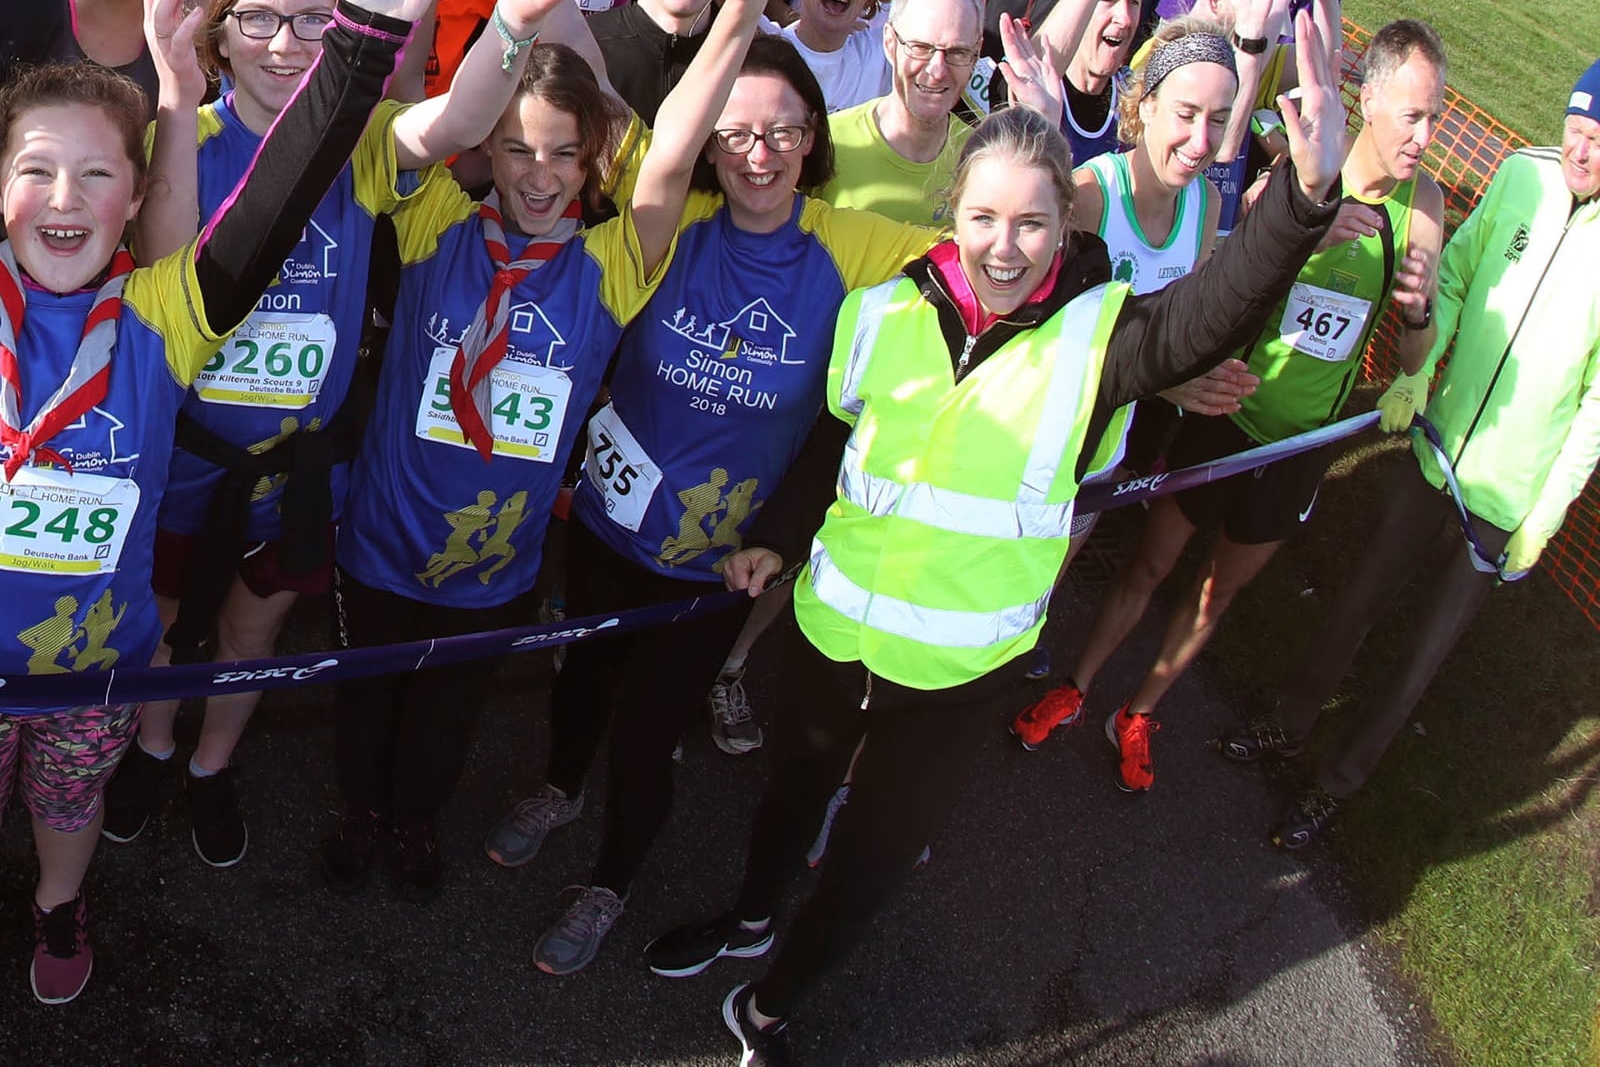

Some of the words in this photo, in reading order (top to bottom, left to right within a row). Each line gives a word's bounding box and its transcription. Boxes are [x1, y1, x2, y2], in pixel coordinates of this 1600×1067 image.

[282, 258, 322, 279] Simon
[1296, 307, 1351, 340] 467
[257, 330, 286, 341] HOME
[287, 332, 309, 342] RUN
[741, 340, 778, 361] Simon
[686, 349, 753, 385] Simon
[218, 374, 261, 385] Kilternan
[263, 377, 290, 387] Scouts
[491, 378, 519, 391] HOME
[519, 383, 540, 394] RUN
[656, 359, 722, 398] HOME
[726, 384, 778, 410] RUN
[249, 384, 285, 394] Deutsche
[285, 387, 304, 395] Bank
[431, 377, 554, 431] 543
[689, 396, 727, 416] 2018
[510, 435, 529, 444] Bank
[75, 451, 101, 460] Dublin
[594, 432, 639, 496] 755
[41, 492, 77, 505] HOME
[78, 496, 104, 506] RUN
[23, 547, 66, 561] Deutsche
[66, 552, 90, 562] Bank
[10, 556, 56, 570] Jog/Walk
